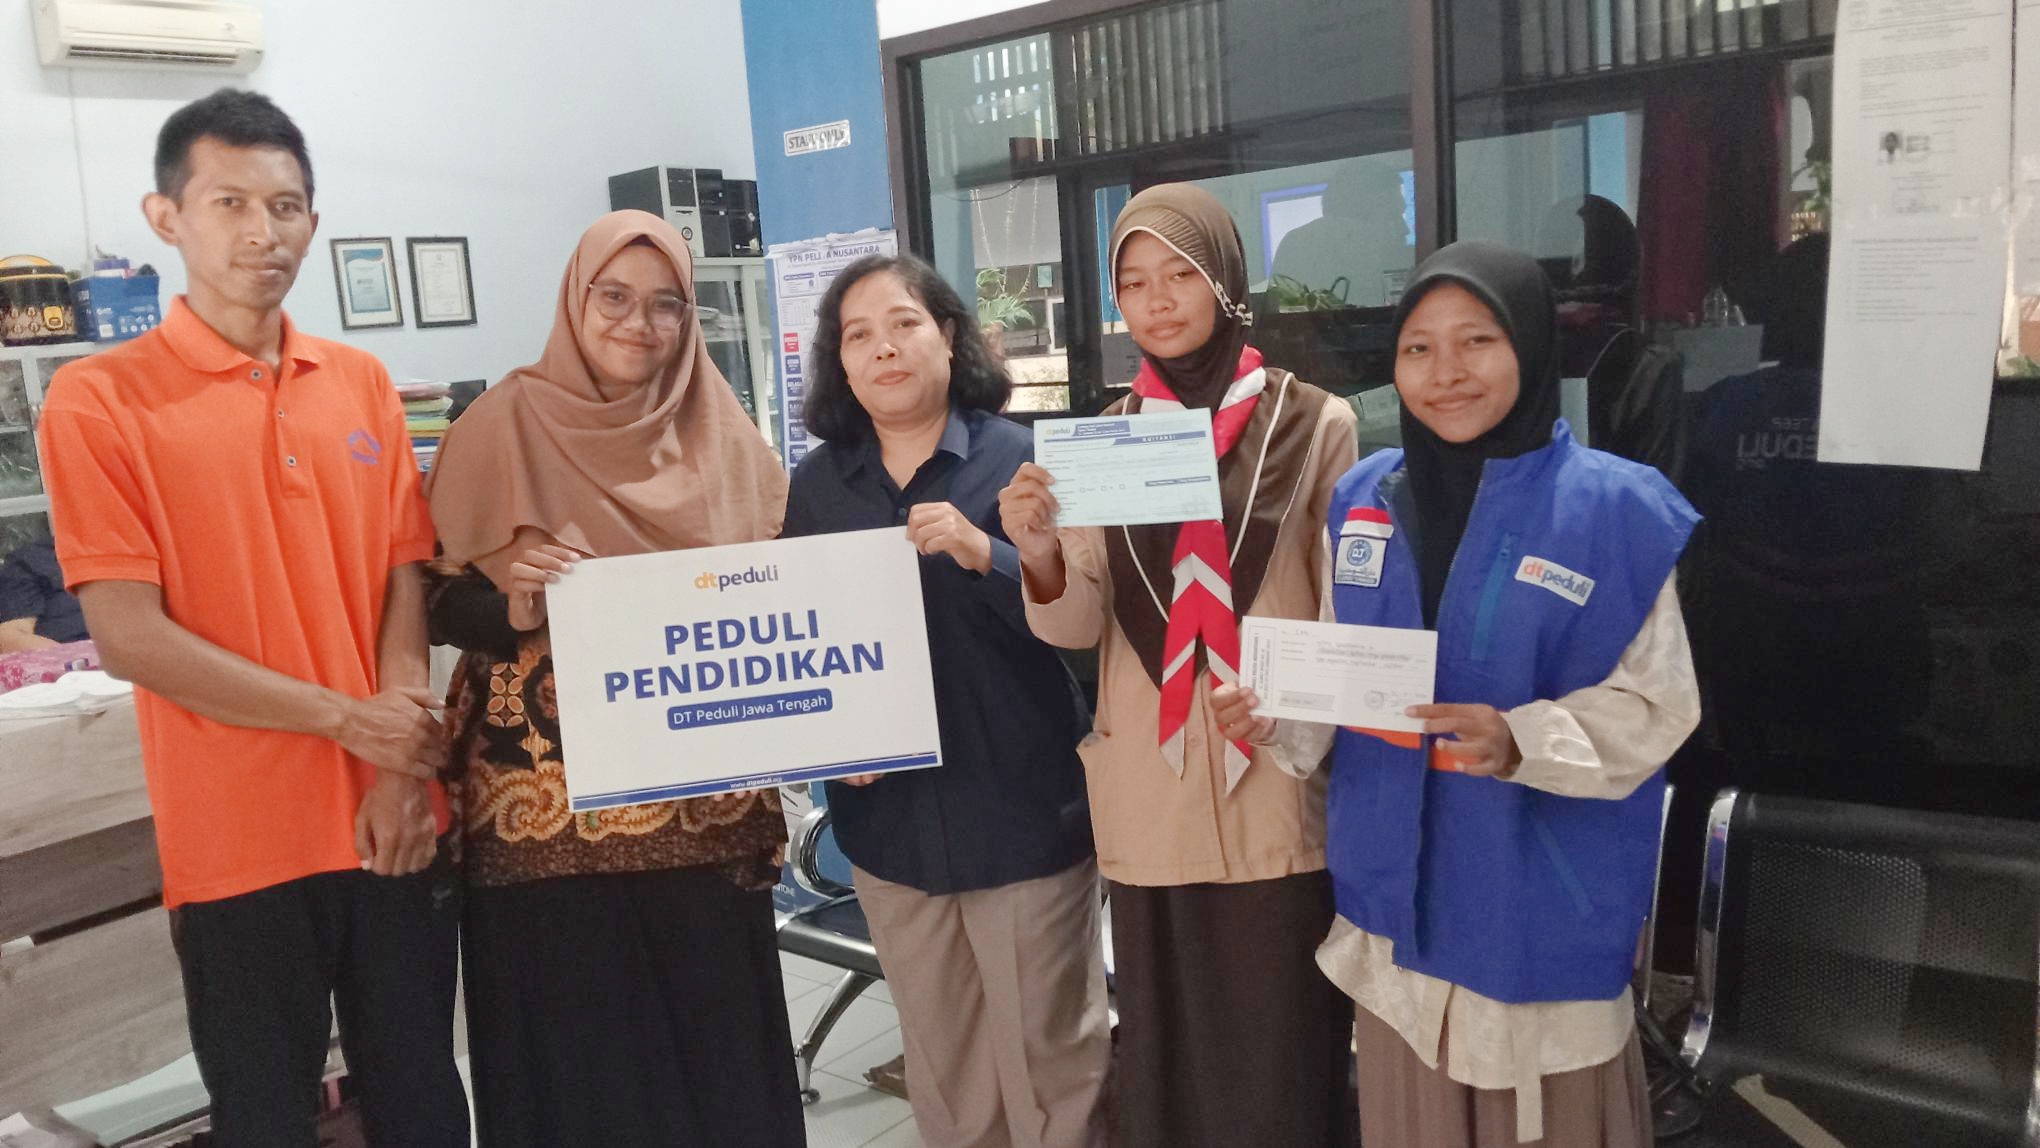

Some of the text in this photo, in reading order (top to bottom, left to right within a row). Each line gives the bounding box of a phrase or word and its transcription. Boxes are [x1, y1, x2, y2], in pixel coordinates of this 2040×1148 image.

[804, 251, 832, 261] PELIA
[832, 245, 880, 258] NUSANTARA
[694, 564, 779, 591] dtpeduli
[1524, 561, 1589, 598] dtpeduli
[664, 609, 820, 656] PEDULI
[604, 641, 885, 703] PENDIDIKAN
[673, 695, 828, 725] DT Peduli Jawa Tengah
